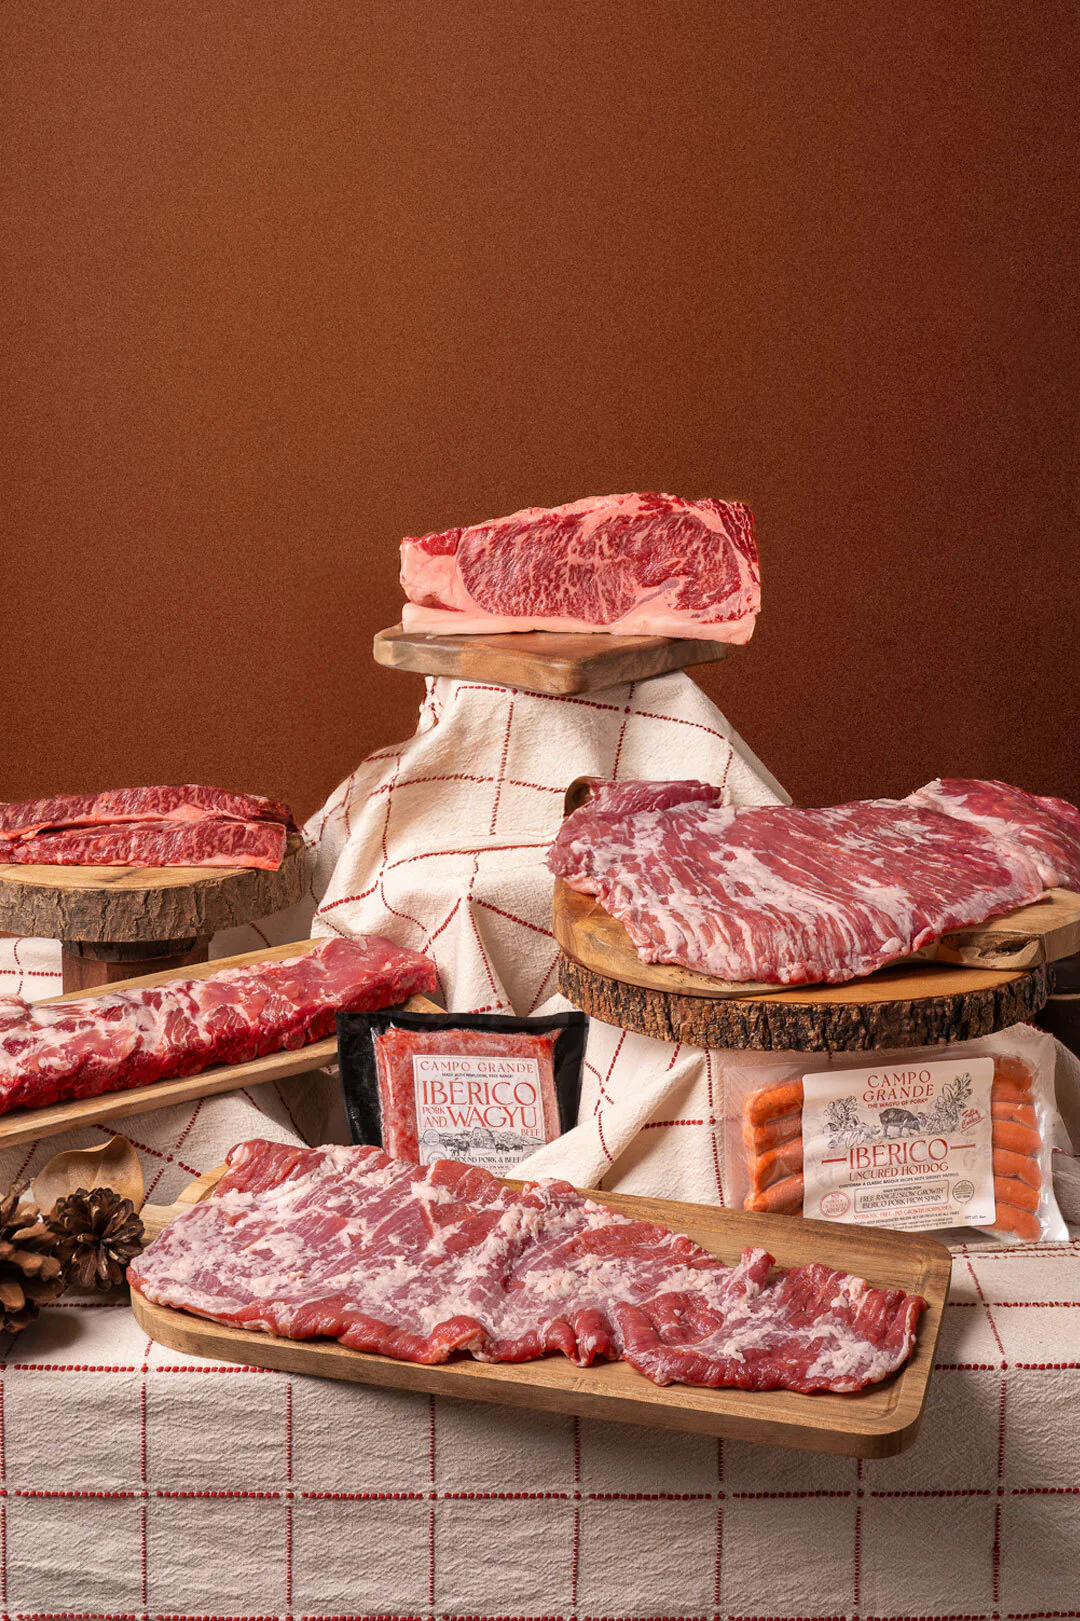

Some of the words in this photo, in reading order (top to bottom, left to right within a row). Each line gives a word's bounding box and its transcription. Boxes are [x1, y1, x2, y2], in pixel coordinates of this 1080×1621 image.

[420, 1061, 471, 1072] CAMPO
[477, 1061, 534, 1074] GRANDE
[867, 1069, 931, 1089] CAMPO
[422, 1077, 537, 1106] IBÉRICO
[862, 1083, 935, 1103] GRANDE
[422, 1106, 446, 1115] PORK
[423, 1116, 448, 1128] AND
[445, 1106, 537, 1128] WAGYU
[520, 1129, 540, 1137] BEEF
[849, 1138, 948, 1170] IBÉRICO
[849, 1167, 898, 1182] UNCURED
[901, 1161, 949, 1176] HOTDOG
[859, 1195, 875, 1203] FREE
[887, 1198, 906, 1207] PORK
[906, 1196, 923, 1204] FROM
[924, 1194, 941, 1202] SPAIN
